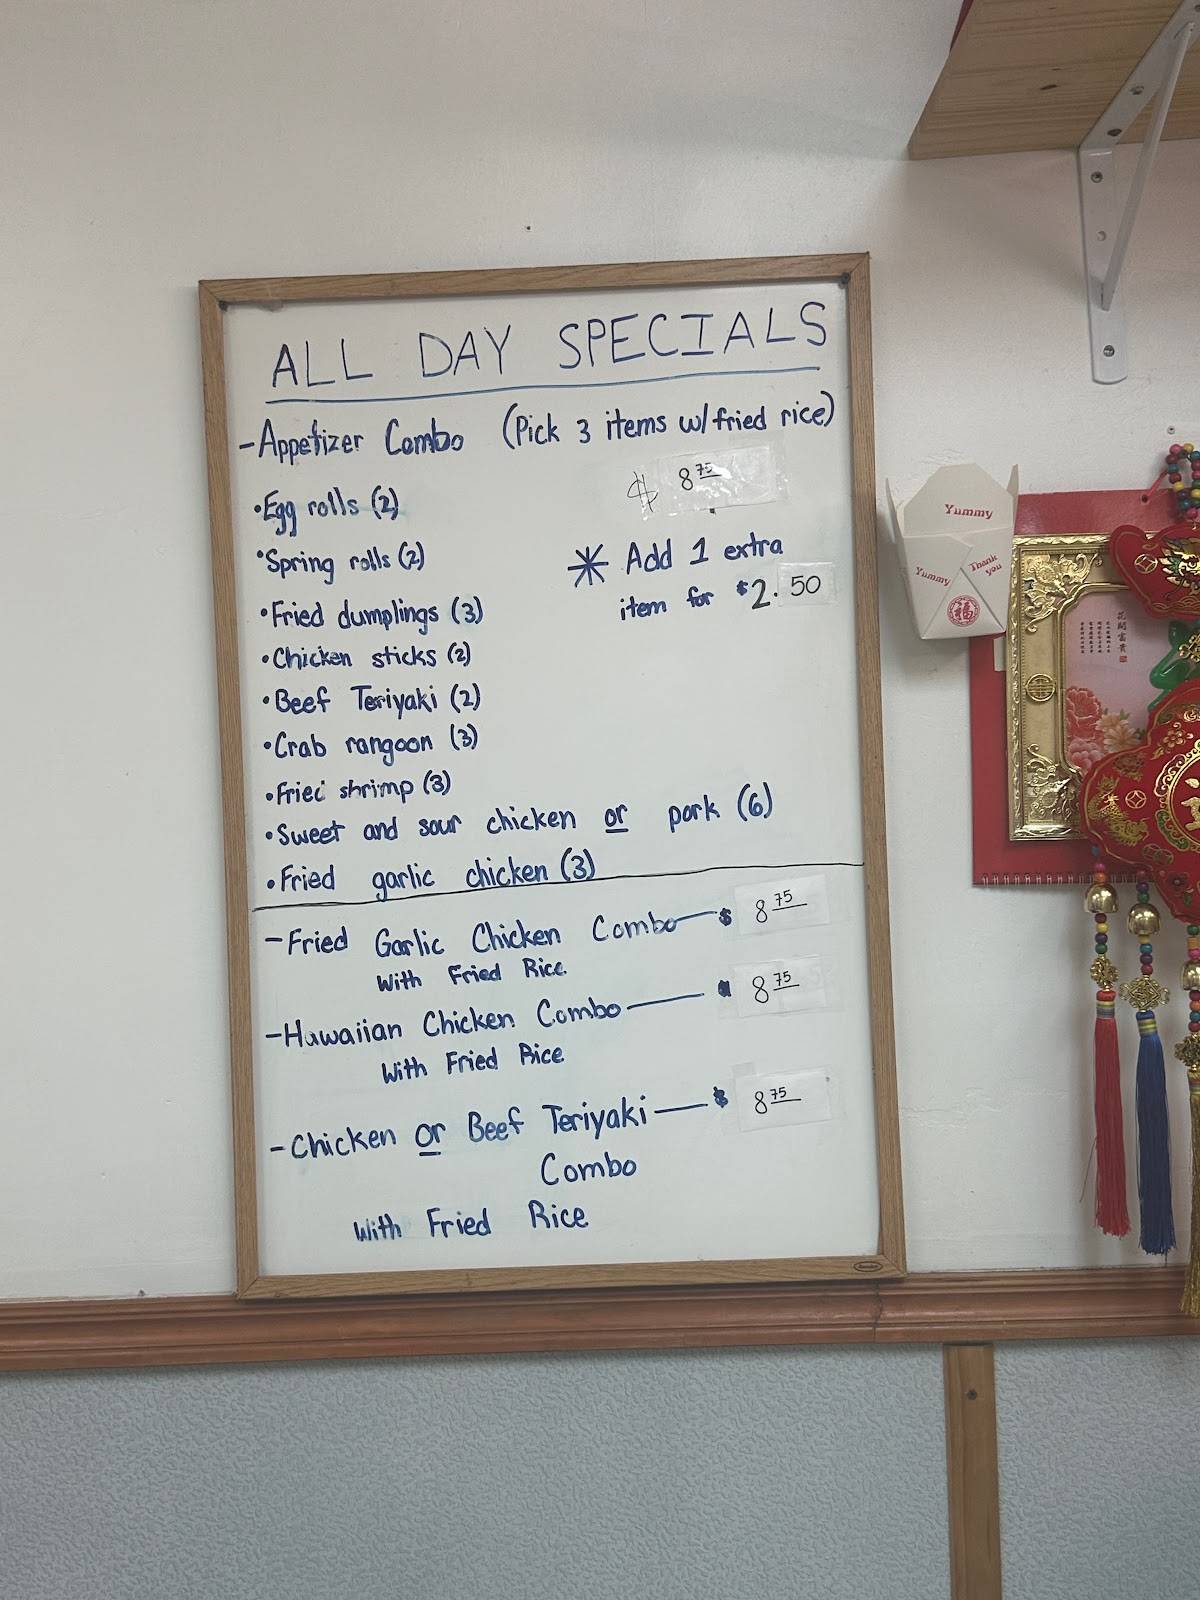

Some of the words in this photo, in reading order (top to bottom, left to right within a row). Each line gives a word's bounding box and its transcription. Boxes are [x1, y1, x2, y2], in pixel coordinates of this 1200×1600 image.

[271, 337, 375, 390] ALL
[418, 323, 512, 379] DAY
[558, 301, 828, 371] SPECIALS
[384, 416, 465, 457] Combo
[502, 402, 561, 451] (Pick
[576, 418, 591, 446] 3
[605, 407, 668, 442] items
[779, 390, 836, 429] rice)
[263, 489, 298, 538] Egg
[307, 486, 360, 518] rolls
[370, 484, 399, 521] (2)
[944, 503, 994, 520] Yummy
[265, 547, 335, 586] Spring
[349, 545, 392, 572] rolls
[397, 540, 425, 572] (2)
[626, 537, 673, 575] Add
[689, 536, 710, 566] 1
[723, 531, 784, 561] extra
[968, 554, 999, 572] Thank
[985, 564, 1003, 577] you
[915, 565, 952, 587] Yummy
[271, 599, 325, 629] Fried
[337, 597, 440, 636] dumplings
[450, 595, 484, 625] (3)
[619, 595, 668, 621] item
[685, 585, 715, 608] for
[272, 645, 353, 671] Chicken
[371, 644, 437, 669] sticks
[446, 640, 472, 668] (2)
[274, 685, 332, 716] Beef
[349, 683, 439, 721] Teriyaki
[449, 682, 481, 714] (2)
[274, 730, 327, 759] Crab
[344, 733, 434, 768] rangoon
[449, 722, 479, 752] (3)
[339, 778, 415, 805] shrimp
[422, 769, 452, 797] (3)
[276, 820, 346, 847] Sweet
[362, 815, 399, 841] and
[418, 814, 463, 837] sour
[486, 805, 577, 835] chicken
[604, 803, 630, 834] or
[667, 793, 721, 834] pork
[736, 781, 773, 823] (6)
[280, 863, 336, 893] Fried
[371, 862, 436, 903] garlic
[465, 855, 549, 889] chicken
[560, 846, 597, 883] (3)
[374, 926, 446, 958] Garlic
[471, 918, 562, 954] Chicken
[592, 913, 679, 943] Combo
[376, 968, 423, 993] With
[447, 962, 502, 986] Fried
[521, 956, 568, 979] Rice
[422, 1005, 515, 1038] Chicken
[536, 996, 622, 1028] Combo
[381, 1055, 428, 1085] With
[445, 1045, 499, 1076] Fried
[518, 1042, 566, 1067] Rice
[414, 1122, 447, 1157] or
[467, 1105, 525, 1143] Beef
[541, 1094, 648, 1141] Teriyaki
[540, 1151, 638, 1187] Combo
[352, 1212, 403, 1243] With
[426, 1206, 492, 1239] Fried
[527, 1199, 590, 1229] Rice
